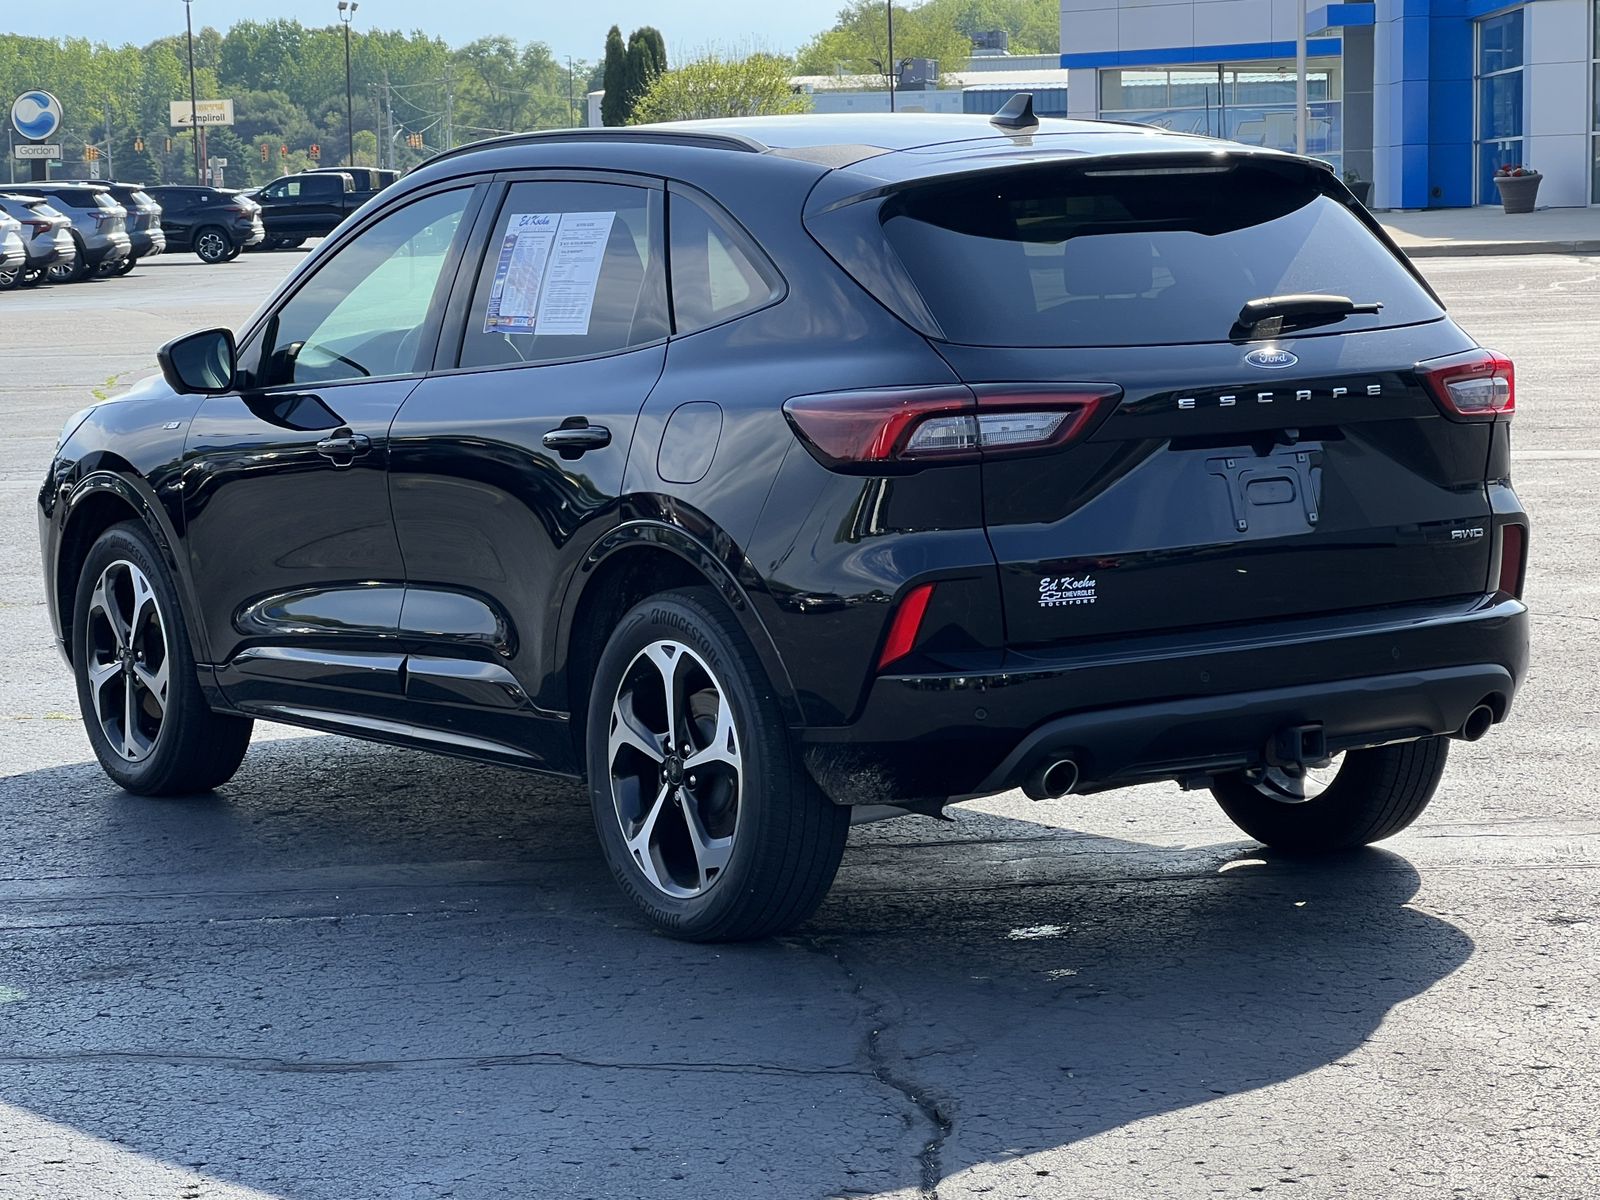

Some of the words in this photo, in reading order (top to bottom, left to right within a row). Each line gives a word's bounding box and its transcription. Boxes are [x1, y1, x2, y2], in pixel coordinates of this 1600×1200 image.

[190, 113, 226, 123] Ampliroll
[19, 146, 55, 155] Gordon
[518, 214, 530, 227] Ed
[1258, 351, 1288, 363] Ford
[1178, 384, 1382, 409] ESCAPE
[1451, 527, 1484, 539] AWD
[1039, 577, 1059, 592] Ed
[1060, 575, 1096, 590] Koehn
[1062, 588, 1095, 598] CHEVROLET
[1040, 598, 1096, 607] ROCKFORD
[650, 607, 723, 671] BRIDGESTONE
[612, 863, 682, 930] BRIDGESTONE
